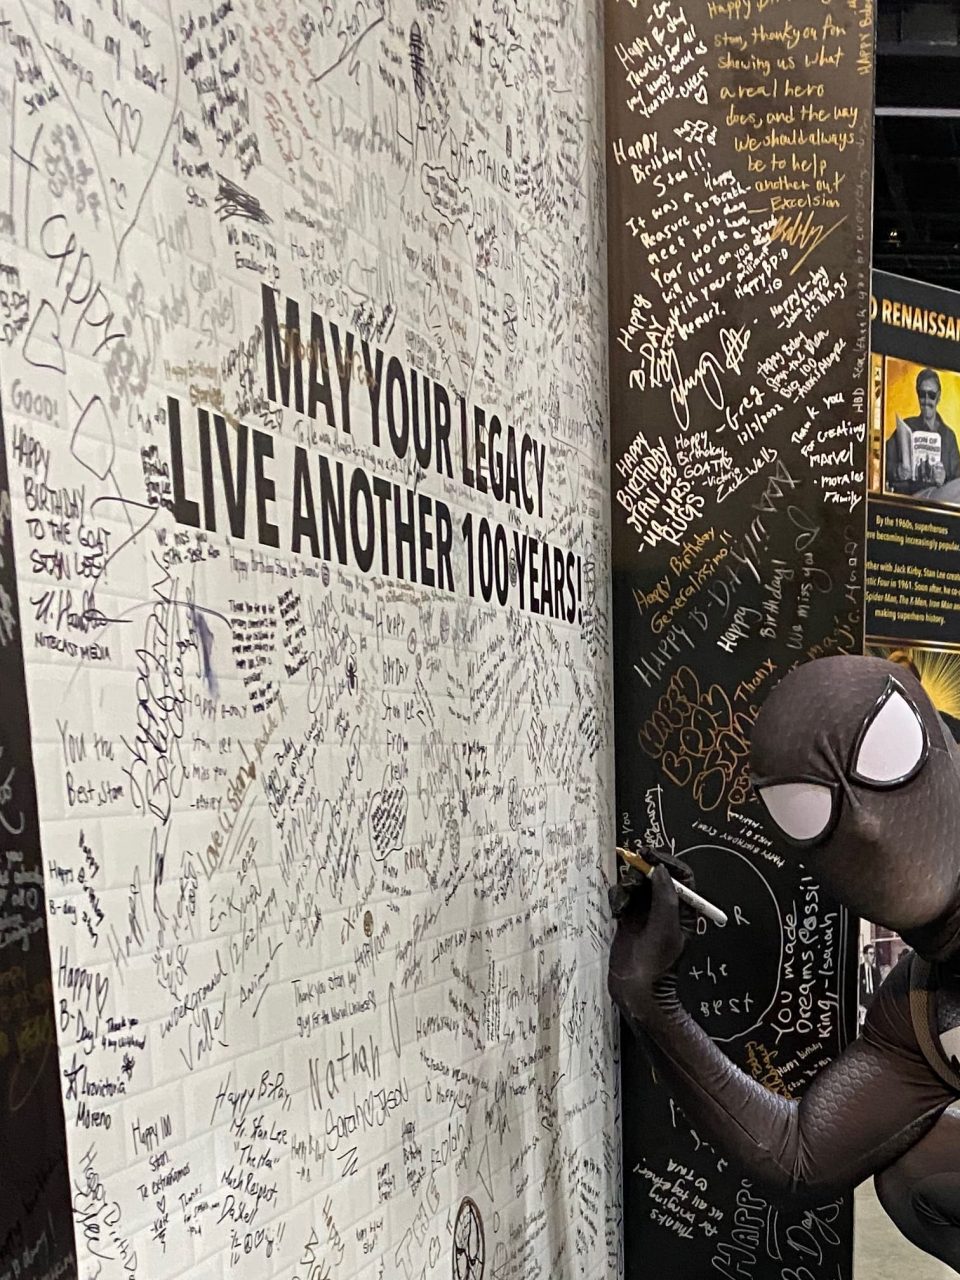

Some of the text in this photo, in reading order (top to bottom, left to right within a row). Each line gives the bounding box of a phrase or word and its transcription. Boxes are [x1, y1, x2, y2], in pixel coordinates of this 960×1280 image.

[785, 81, 825, 97] hero
[766, 106, 795, 123] and
[802, 104, 830, 122] the
[792, 154, 826, 178] help
[261, 282, 546, 518] MAY YOUR LEGACY
[616, 432, 650, 477] HAPPY
[617, 437, 671, 513] BIRTHDAY
[167, 395, 280, 549] LIVE
[291, 446, 455, 592] ANOTHER
[462, 513, 509, 607] 100
[513, 531, 582, 623] YEARS!
[876, 515, 883, 527] By
[885, 516, 894, 526] the
[915, 523, 948, 535] superheroes
[876, 531, 904, 546] becoming
[905, 535, 938, 550] increasingly
[880, 563, 892, 572] with
[894, 564, 905, 573] Jack
[924, 568, 935, 577] Stan
[937, 570, 945, 579] Lee
[878, 577, 890, 587] Four
[915, 582, 928, 592] Soon
[944, 585, 950, 594] he
[900, 594, 908, 604] The
[929, 599, 940, 607] Iron
[941, 600, 953, 609] Man
[875, 609, 896, 621] making
[897, 612, 924, 621] superhero
